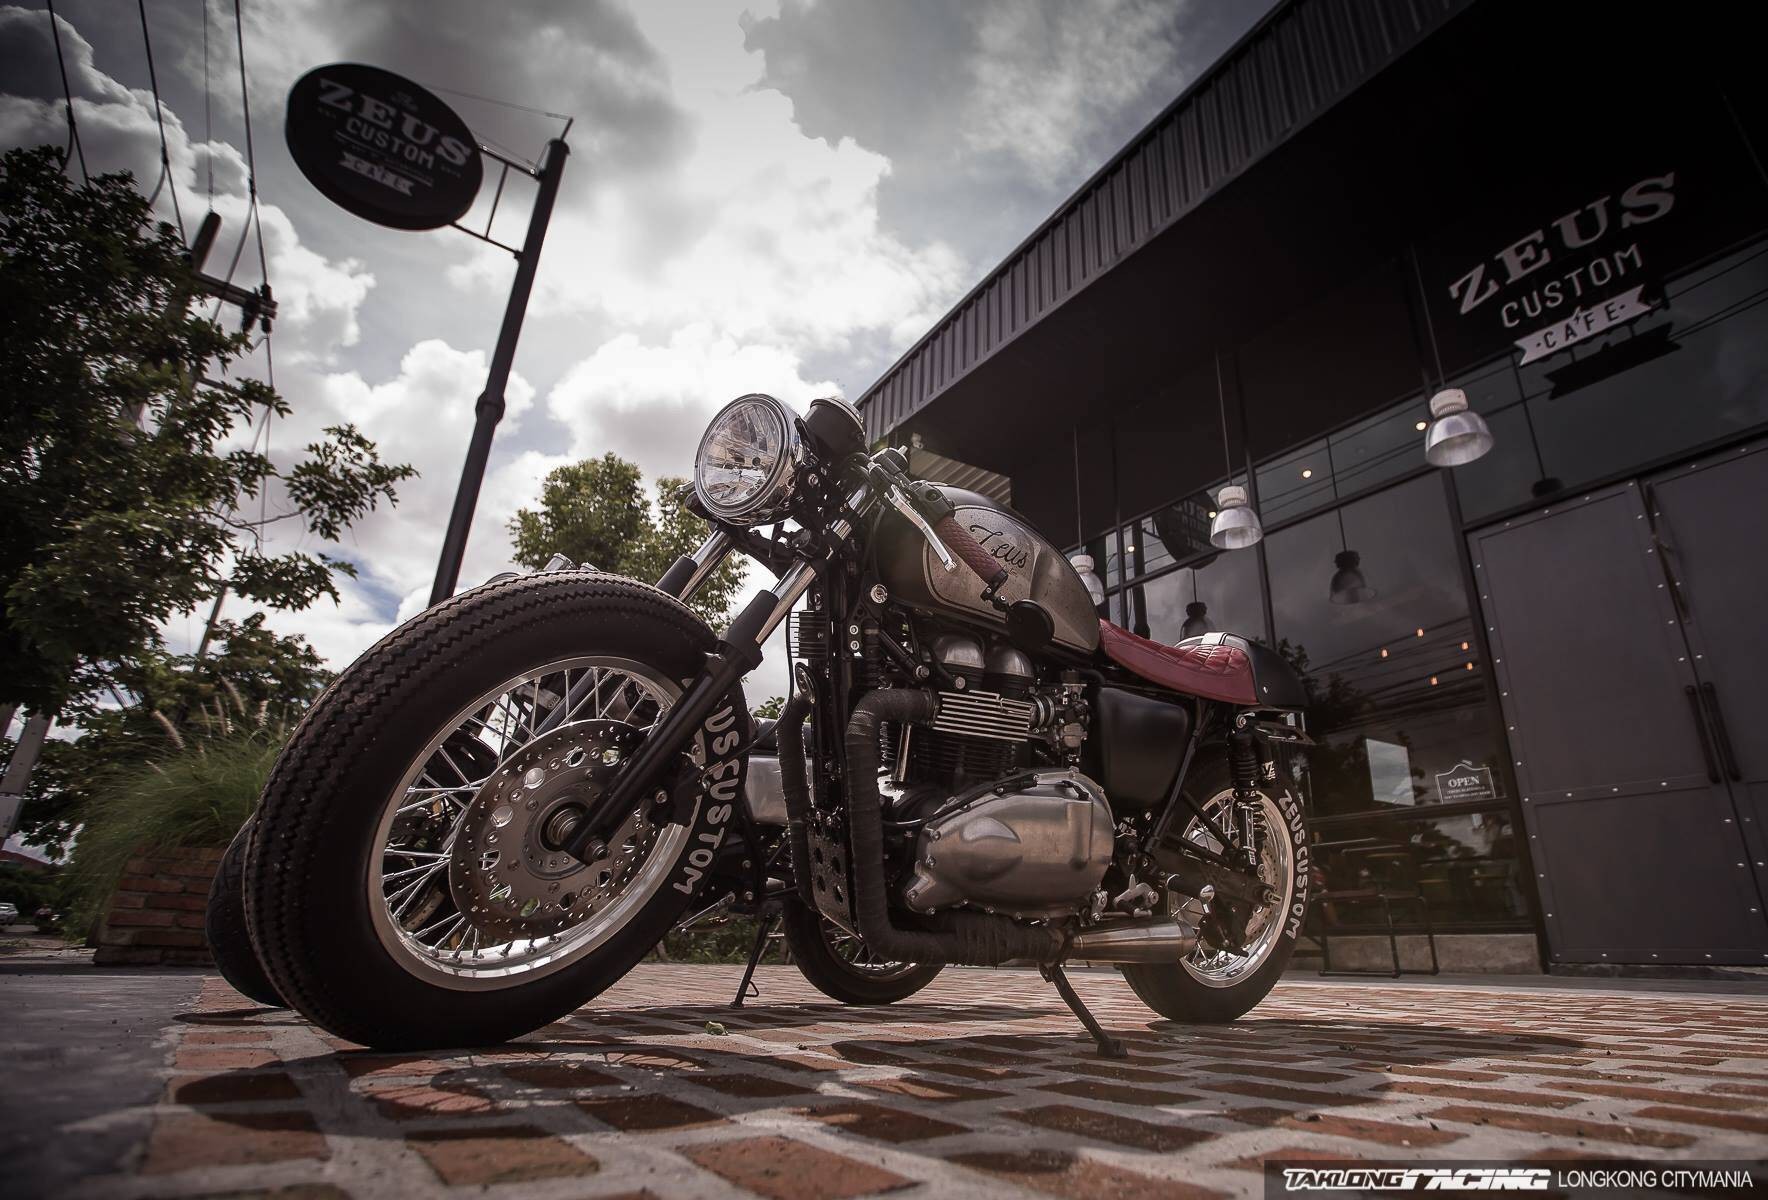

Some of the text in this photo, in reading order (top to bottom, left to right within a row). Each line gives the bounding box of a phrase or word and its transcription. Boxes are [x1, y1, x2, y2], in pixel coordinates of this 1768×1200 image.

[319, 78, 473, 166] ZEUS
[346, 117, 435, 170] CUSTOM
[1448, 171, 1675, 315] ZEUS
[1501, 243, 1642, 328] CUSTOM
[1448, 776, 1480, 788] OPEN
